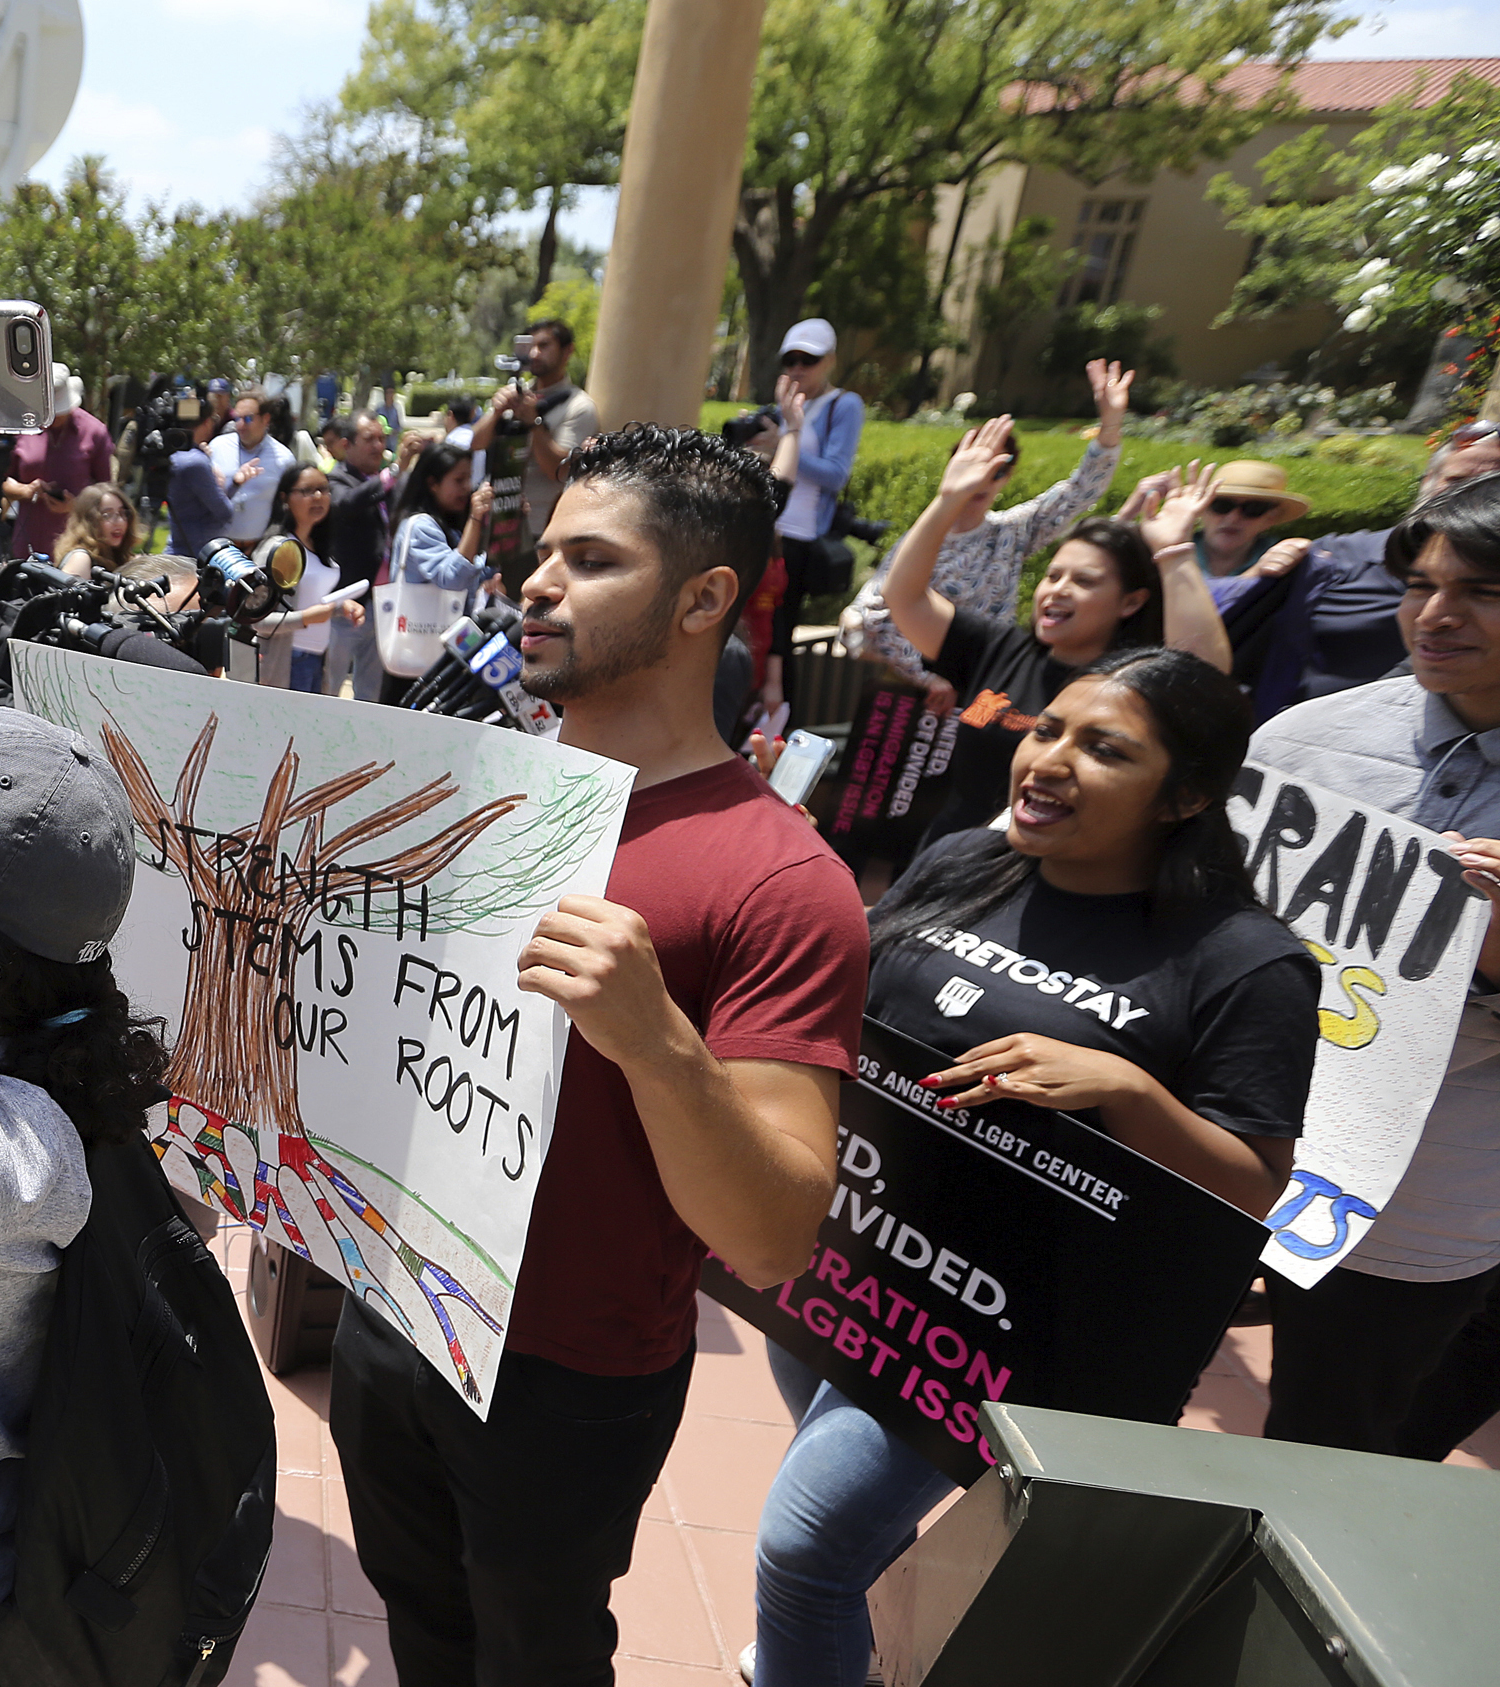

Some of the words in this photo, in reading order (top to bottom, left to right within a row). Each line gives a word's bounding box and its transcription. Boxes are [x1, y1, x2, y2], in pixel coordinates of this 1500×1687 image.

[482, 655, 517, 686] 5
[151, 818, 429, 942] STRENGTH
[182, 901, 358, 997] STEMS
[394, 953, 520, 1081] FROM
[274, 993, 349, 1065] OUR
[396, 1036, 534, 1181] ROOTS
[858, 1054, 881, 1080] OS
[973, 1117, 1031, 1158] LGBT
[808, 1241, 1012, 1402] RATION
[828, 1183, 1013, 1331] IVIDED.
[776, 1279, 901, 1378] LGBT
[900, 1365, 998, 1467] ISS
